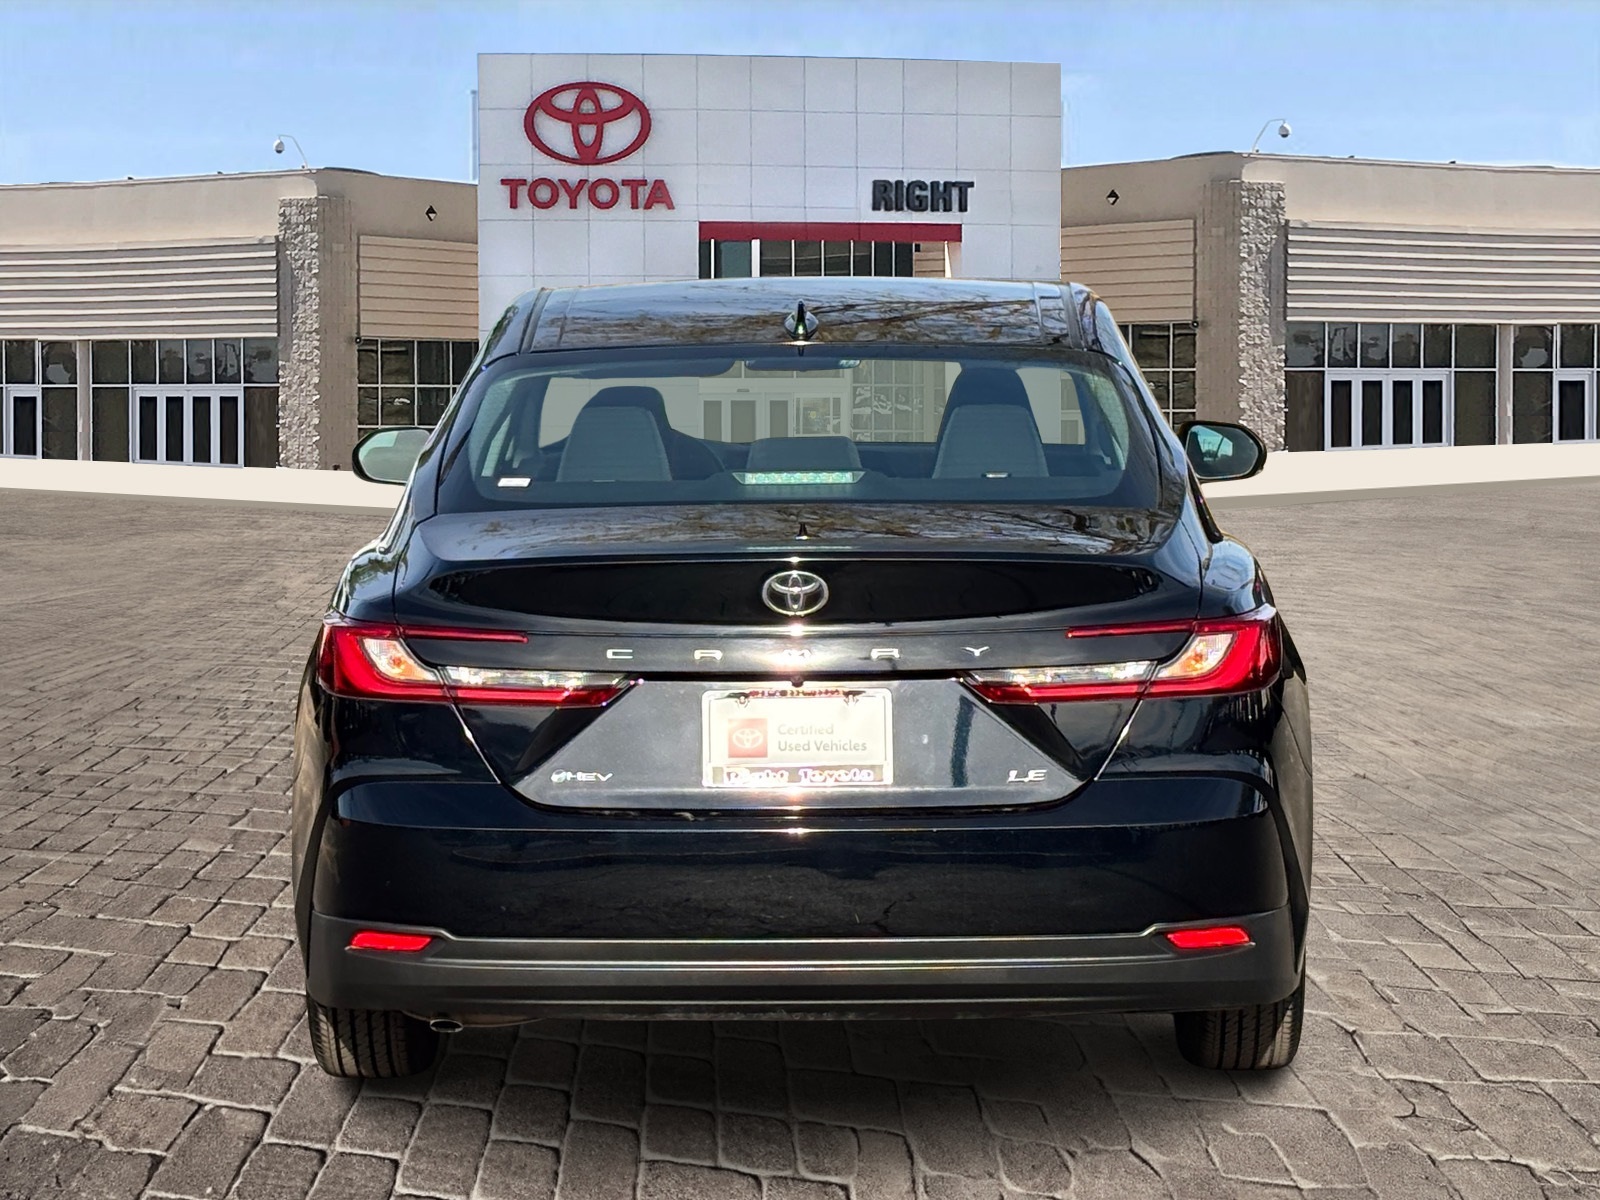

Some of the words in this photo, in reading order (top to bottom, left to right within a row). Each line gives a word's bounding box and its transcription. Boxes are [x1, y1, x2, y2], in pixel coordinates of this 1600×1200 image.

[501, 179, 675, 210] TOYOTA
[872, 180, 974, 212] RIGHT
[777, 722, 834, 736] Certified
[777, 740, 811, 753] Used
[814, 739, 868, 753] Vehicles
[1006, 769, 1047, 783] LE
